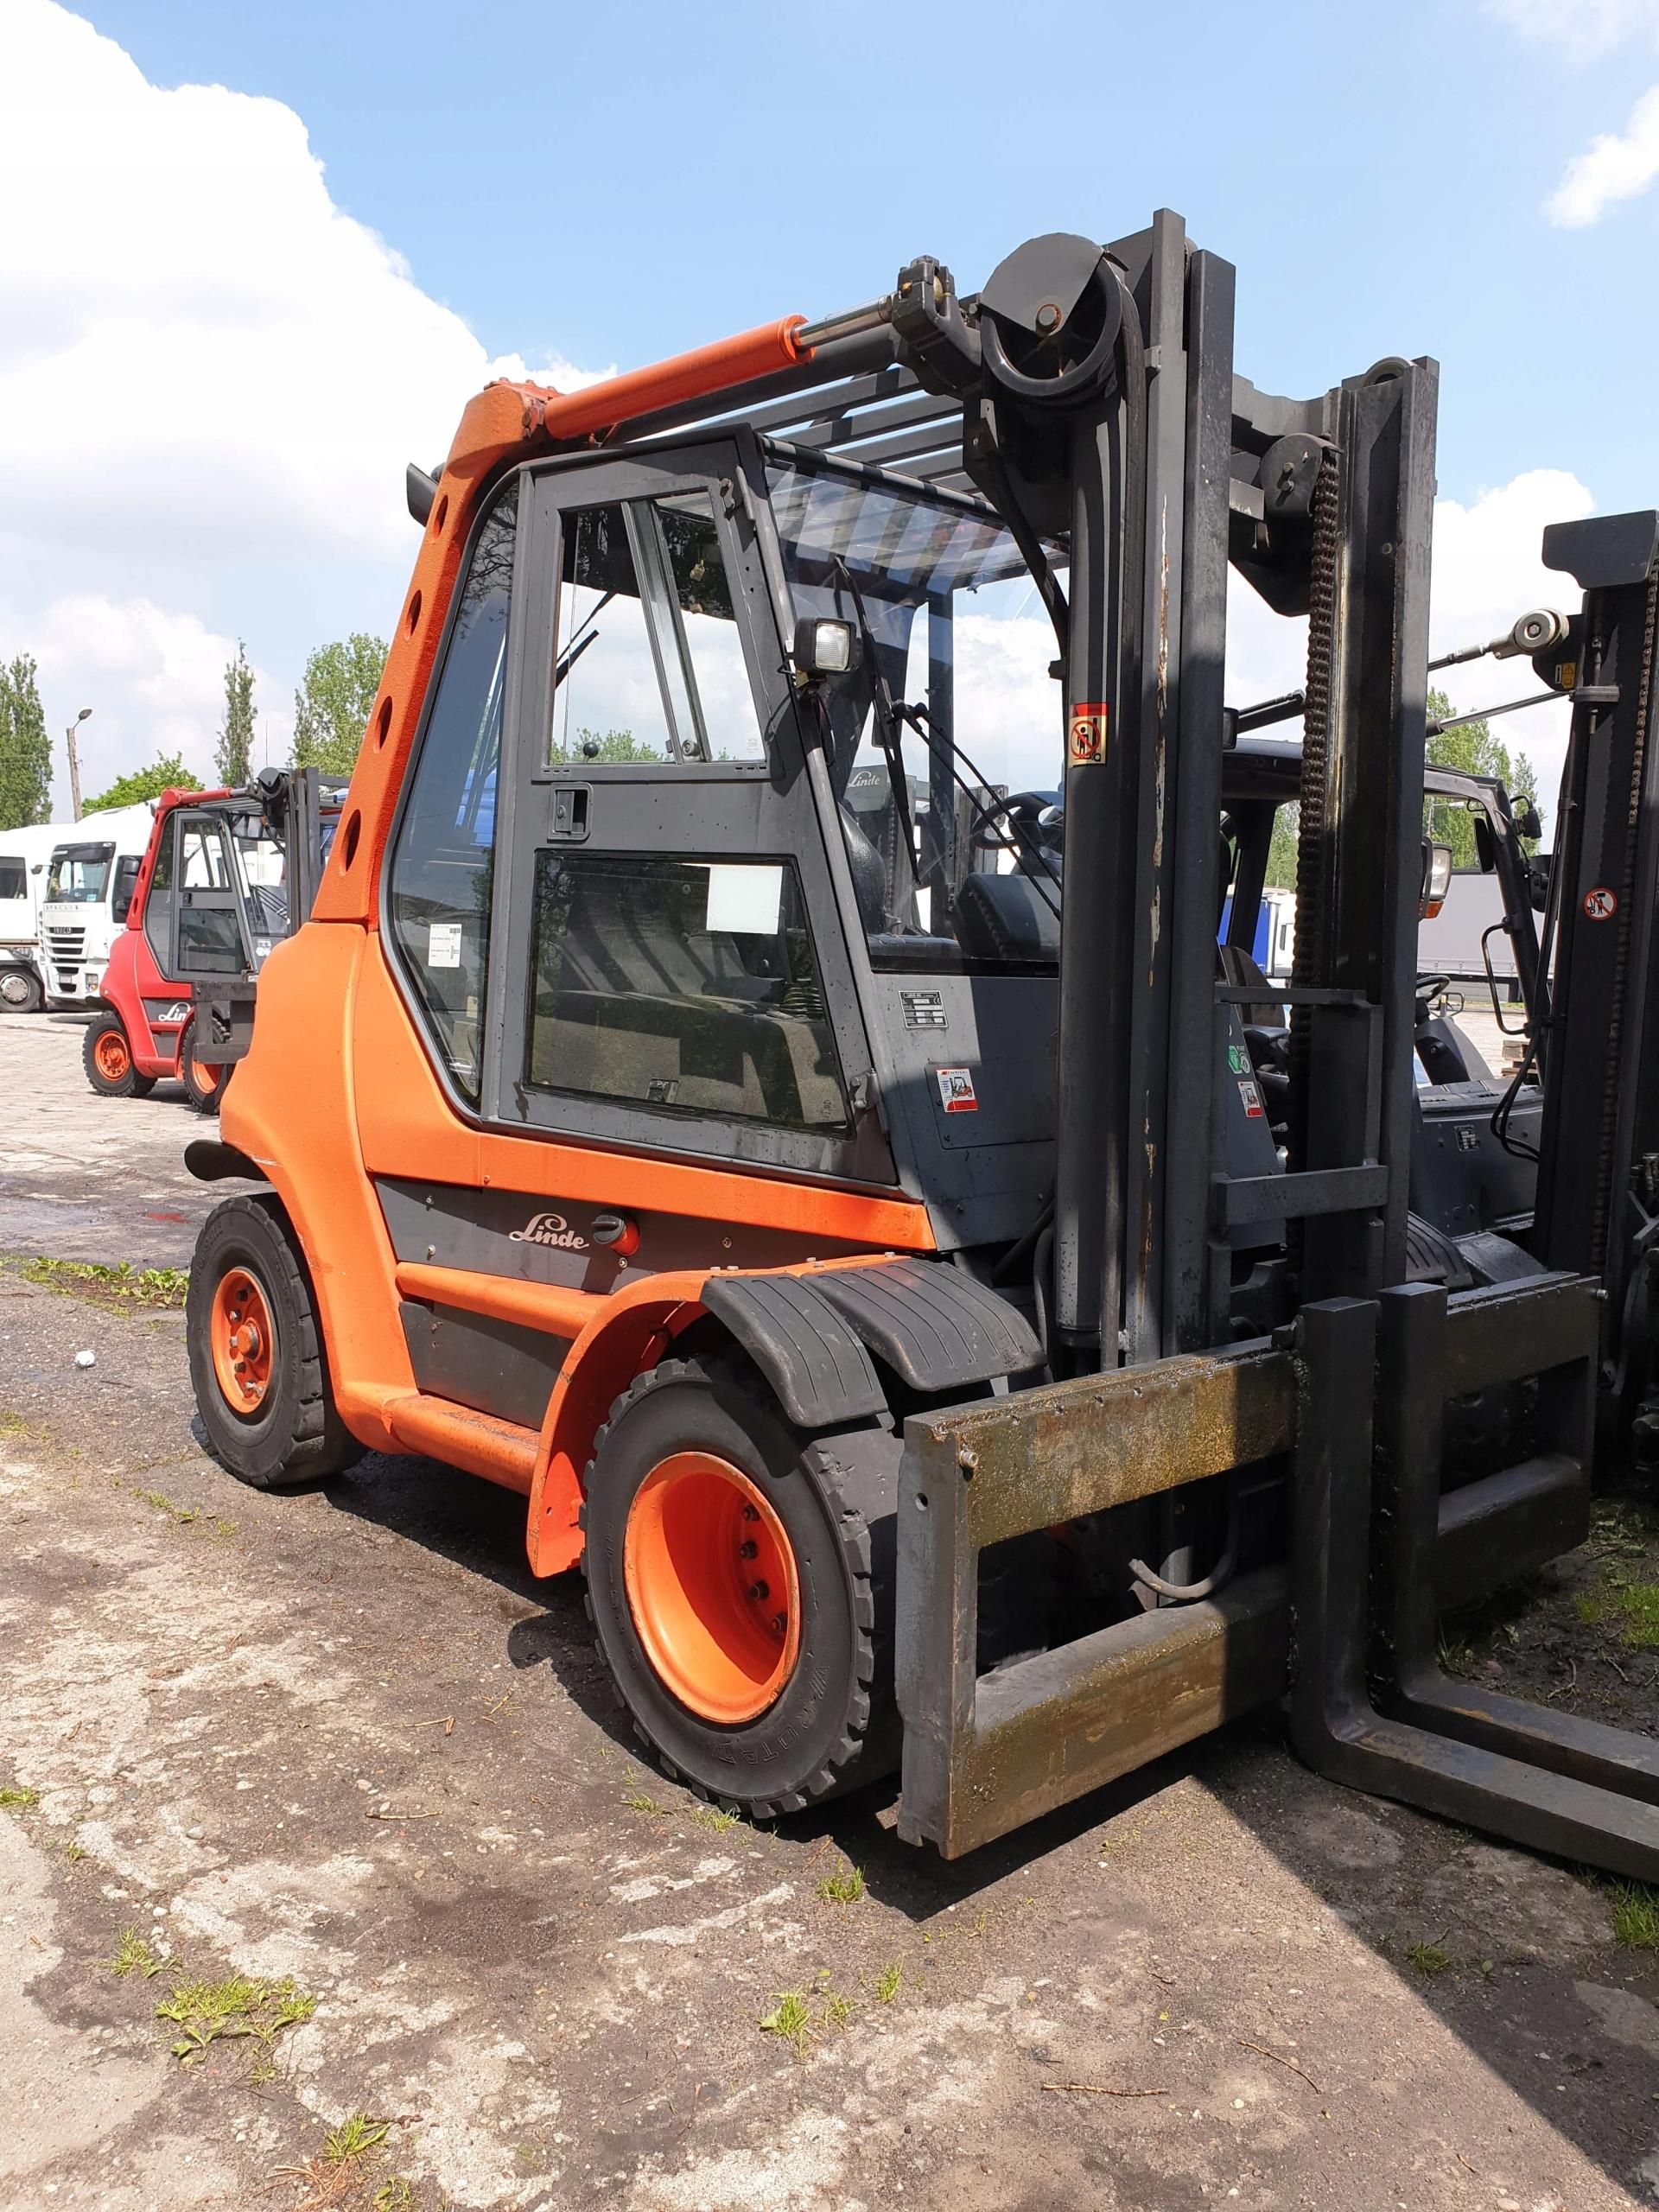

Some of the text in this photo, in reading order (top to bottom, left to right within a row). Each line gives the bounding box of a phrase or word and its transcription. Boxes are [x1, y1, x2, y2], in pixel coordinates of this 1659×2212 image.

[846, 771, 880, 788] Linde
[158, 1001, 191, 1021] Lin
[509, 1213, 589, 1249] Linde
